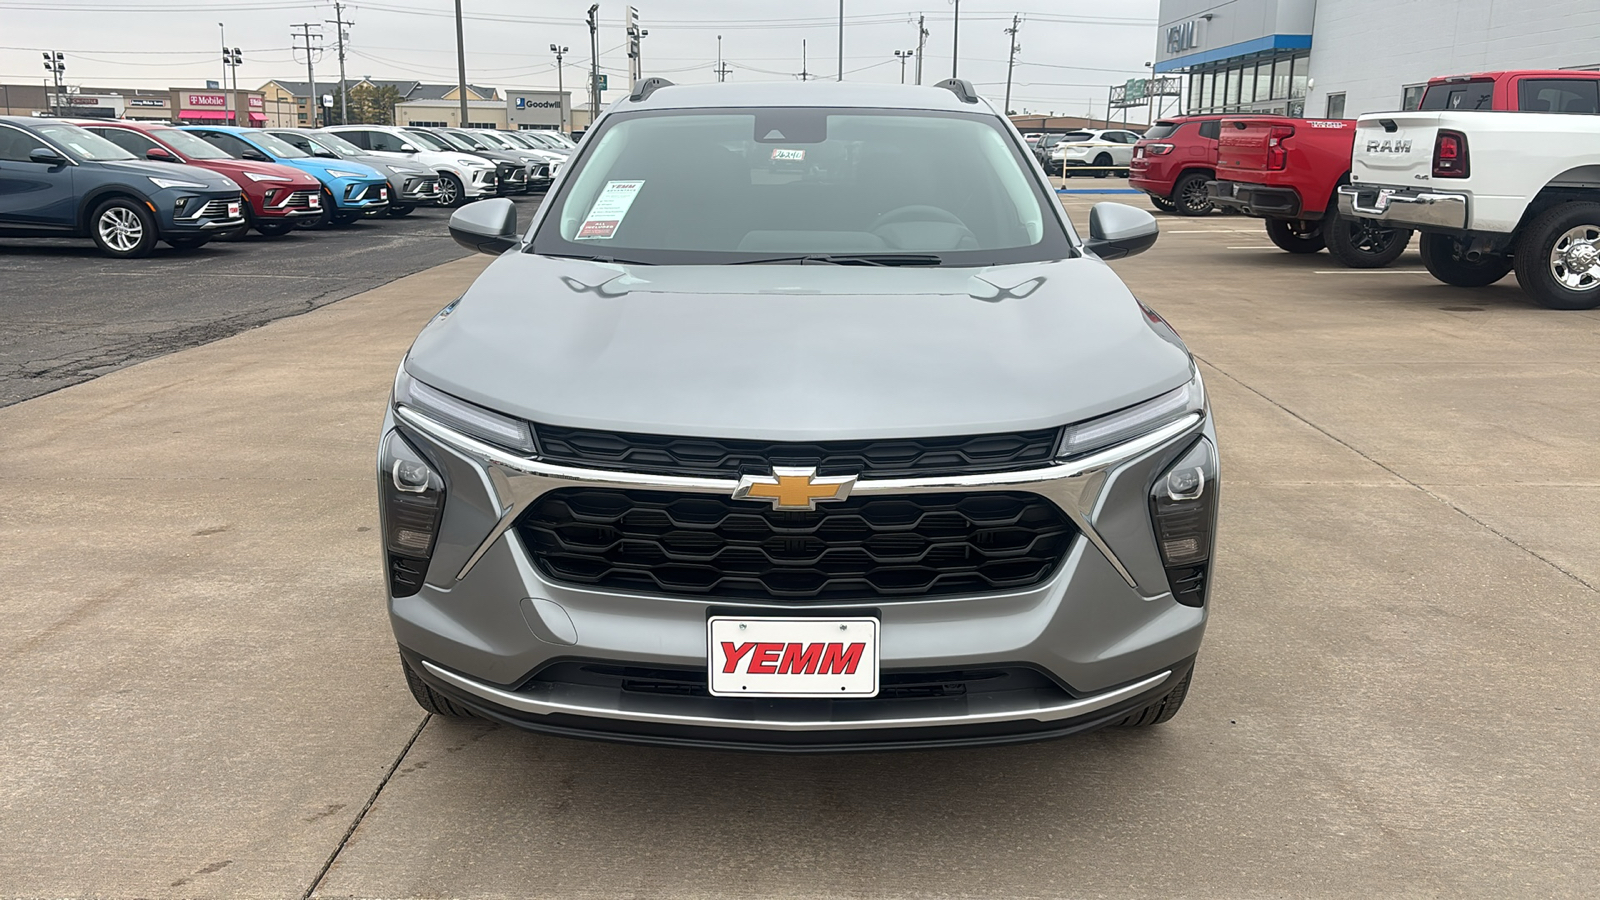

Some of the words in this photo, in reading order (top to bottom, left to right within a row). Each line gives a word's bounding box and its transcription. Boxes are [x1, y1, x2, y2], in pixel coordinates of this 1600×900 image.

[198, 96, 224, 105] Mobile
[526, 100, 561, 109] Goodwill
[1366, 139, 1413, 153] RAM
[720, 641, 866, 675] YEMM
